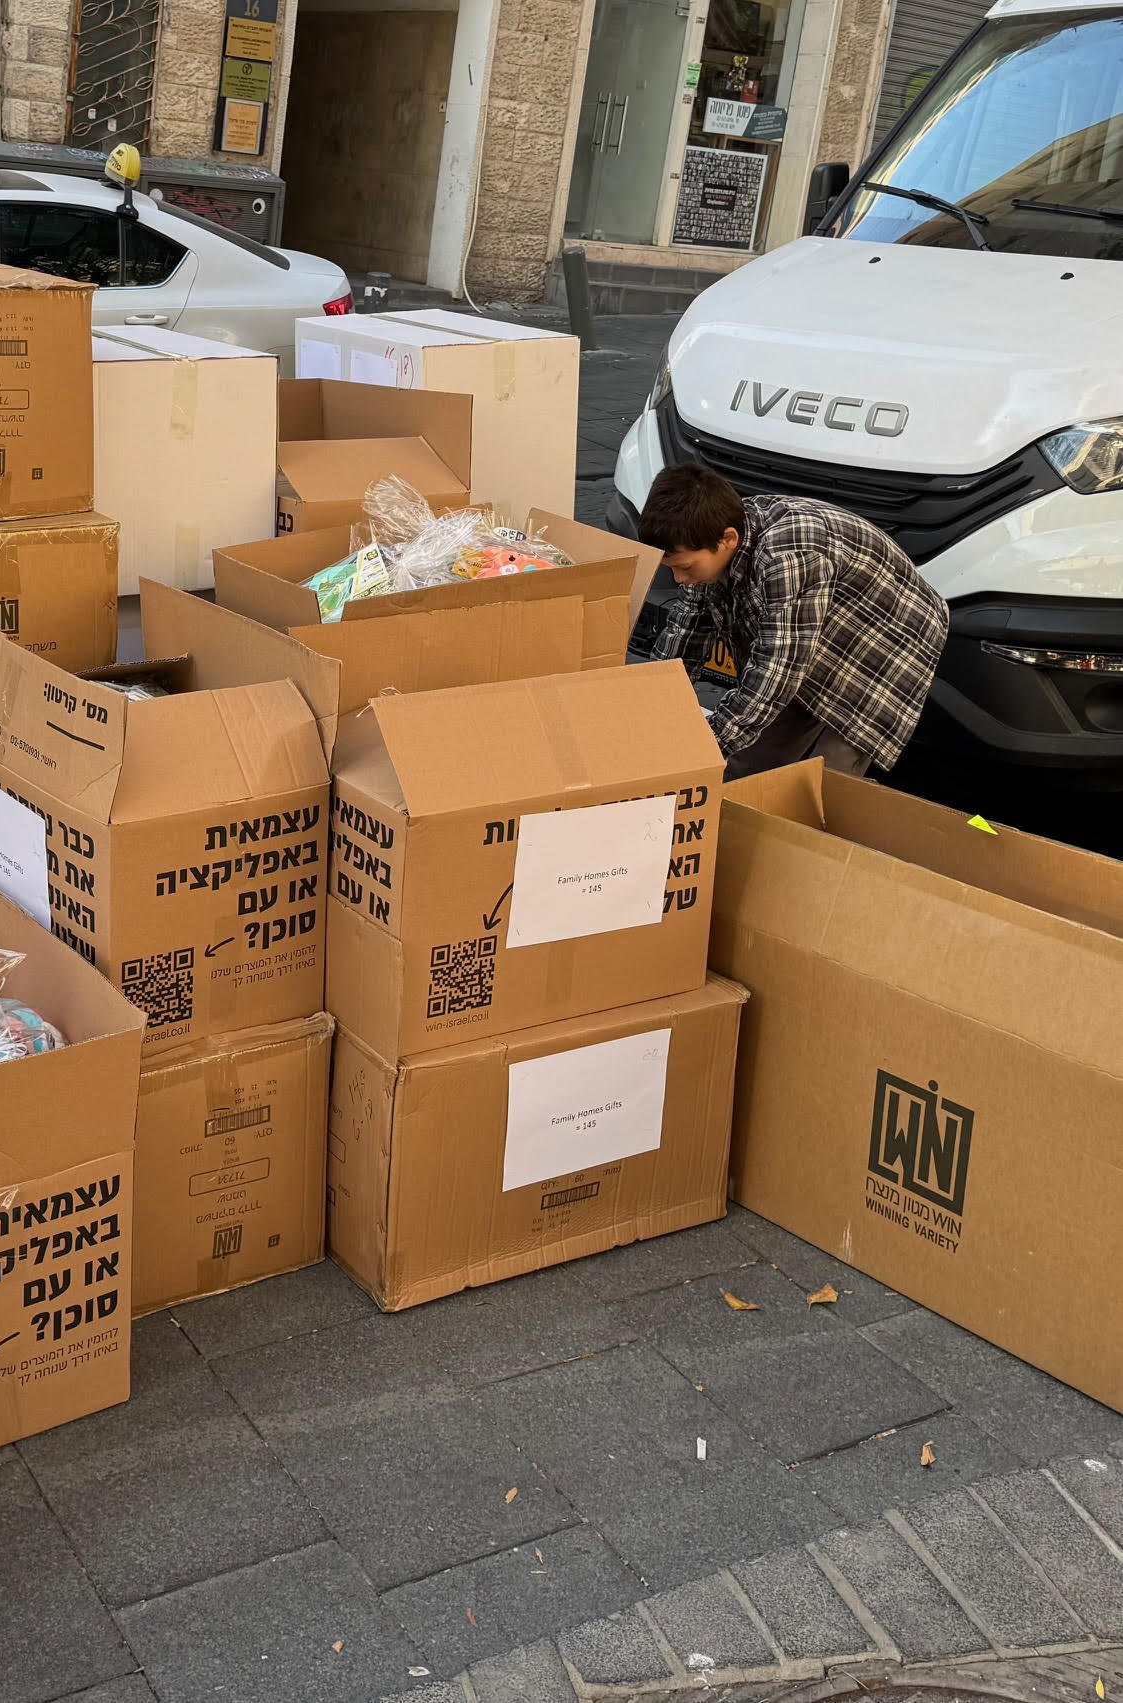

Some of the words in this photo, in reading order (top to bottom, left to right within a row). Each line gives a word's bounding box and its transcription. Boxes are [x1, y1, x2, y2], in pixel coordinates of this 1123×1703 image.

[730, 379, 909, 437] IVECO
[0, 427, 23, 438] לדרך
[44, 683, 77, 714] קרטון:
[204, 804, 320, 851] עצמאית
[335, 796, 394, 849] עצמאי
[58, 820, 94, 859] כבר
[156, 840, 319, 897] באפליקציה
[333, 831, 392, 890] באפלי
[65, 860, 94, 897] את
[288, 874, 318, 904] או
[338, 870, 363, 905] עם
[557, 874, 582, 886] Family
[584, 869, 609, 881] Homes
[611, 866, 628, 878] Gifts
[588, 884, 602, 894] 145
[237, 884, 278, 916] עם
[369, 891, 390, 925] או
[243, 909, 317, 950] סוכן?
[234, 956, 272, 975] המוצרים
[274, 952, 288, 965] את
[289, 944, 317, 963] להזמין
[295, 956, 316, 973] באיזו
[210, 966, 232, 981] שלנו
[231, 975, 244, 990] לך
[245, 968, 275, 986] שנוחה
[276, 963, 293, 978] דרך
[425, 1011, 490, 1033] win-israel.co.il
[551, 1110, 575, 1126] Family
[577, 1105, 604, 1119] Homes
[605, 1099, 623, 1112] Gifts
[582, 1119, 596, 1130] 145
[224, 1136, 236, 1147] 60
[868, 1068, 975, 1217] WIN
[865, 1175, 901, 1206] מנצח
[196, 1207, 236, 1224] משחקים
[238, 1202, 263, 1217] לדרך
[903, 1195, 931, 1222] מגוון
[865, 1196, 910, 1230] WINNING
[914, 1221, 959, 1254] VARIETY
[932, 1207, 963, 1239] WIN
[84, 1251, 119, 1287] או
[23, 1268, 71, 1308] עם
[31, 1289, 119, 1342] סוכן?
[67, 1340, 84, 1354] את
[85, 1328, 120, 1350] להזמין
[93, 1341, 119, 1361] באיזו
[20, 1345, 64, 1372] המוצרים
[33, 1359, 68, 1382] שנוחה
[69, 1351, 91, 1369] דרך
[17, 1369, 32, 1387] לך
